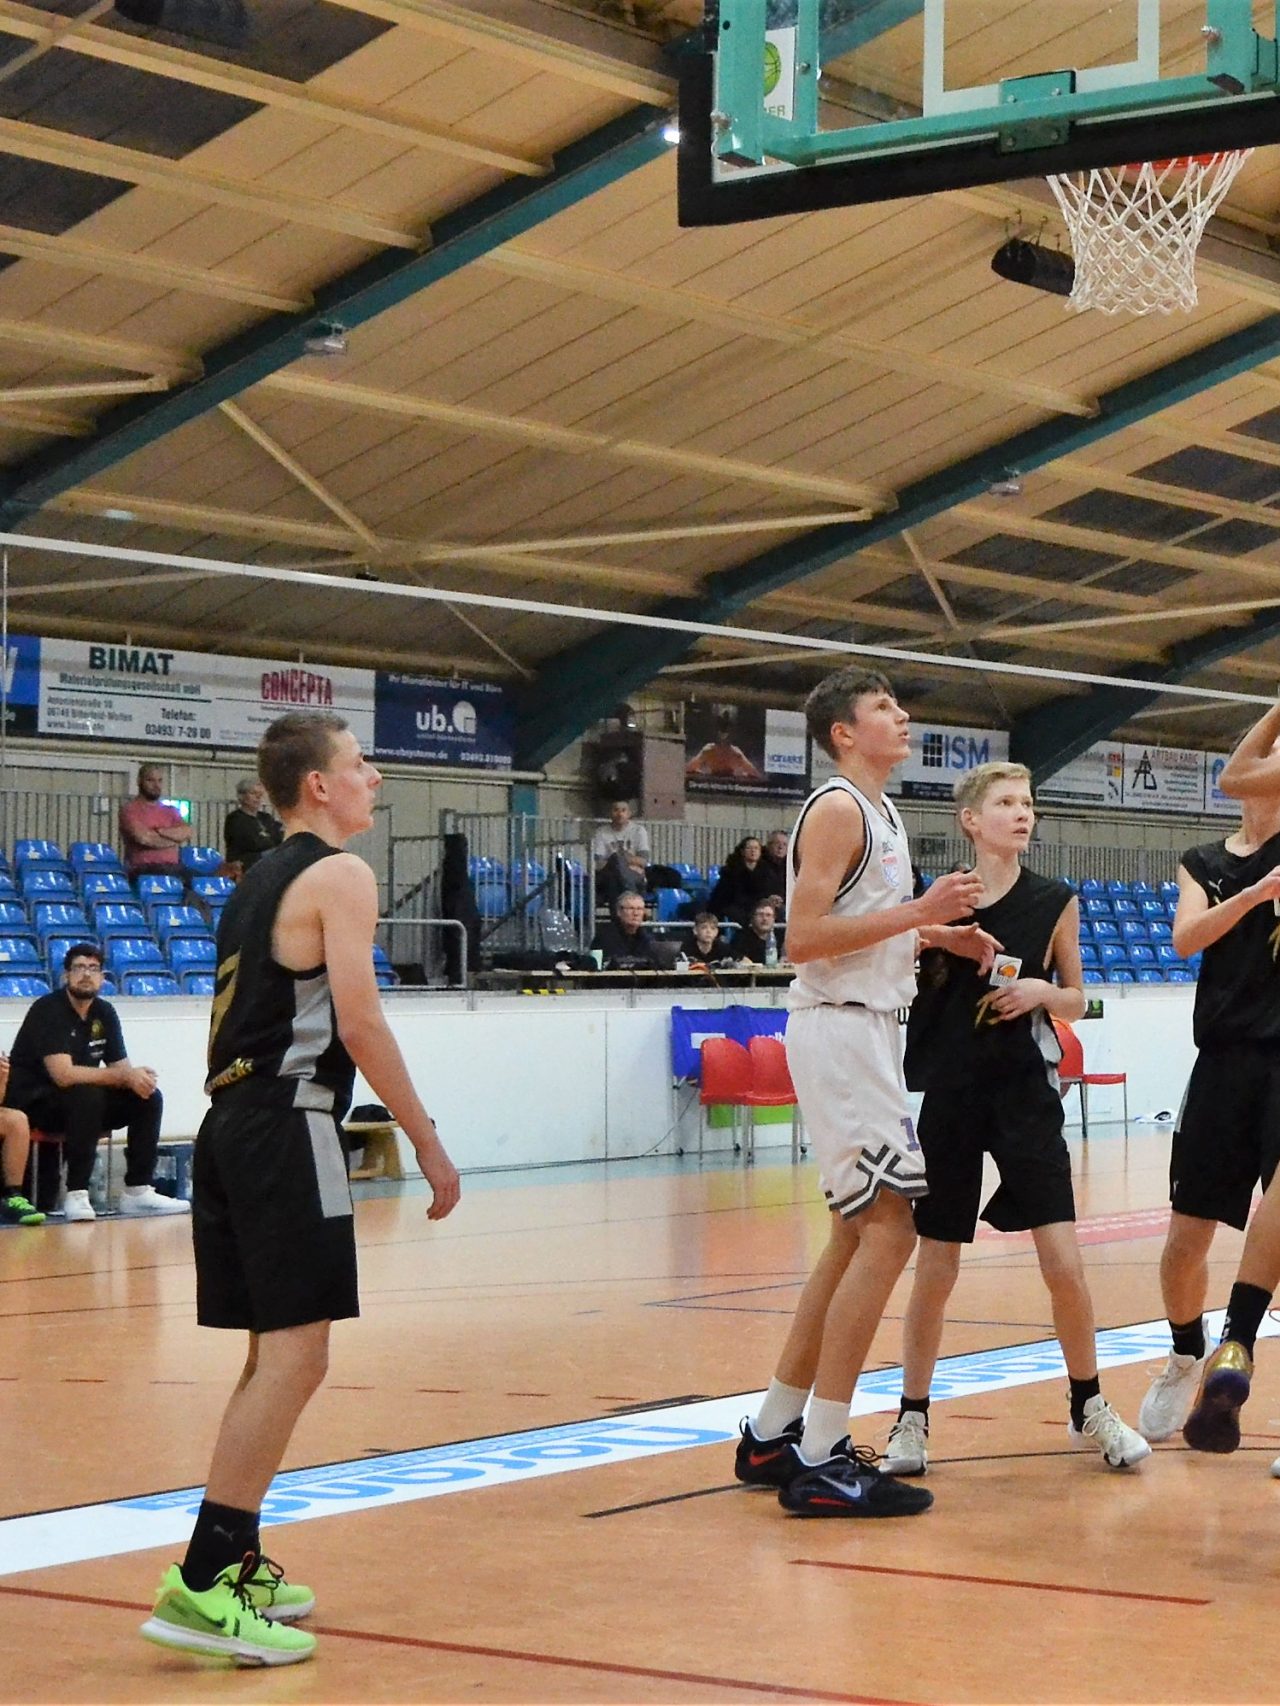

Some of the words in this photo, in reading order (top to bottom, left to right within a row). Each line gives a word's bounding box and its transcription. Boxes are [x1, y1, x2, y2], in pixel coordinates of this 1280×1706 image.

[89, 646, 174, 675] BIMAT
[261, 668, 333, 705] CONCEPTA
[161, 707, 197, 721] Telefon:
[945, 734, 989, 769] ISM
